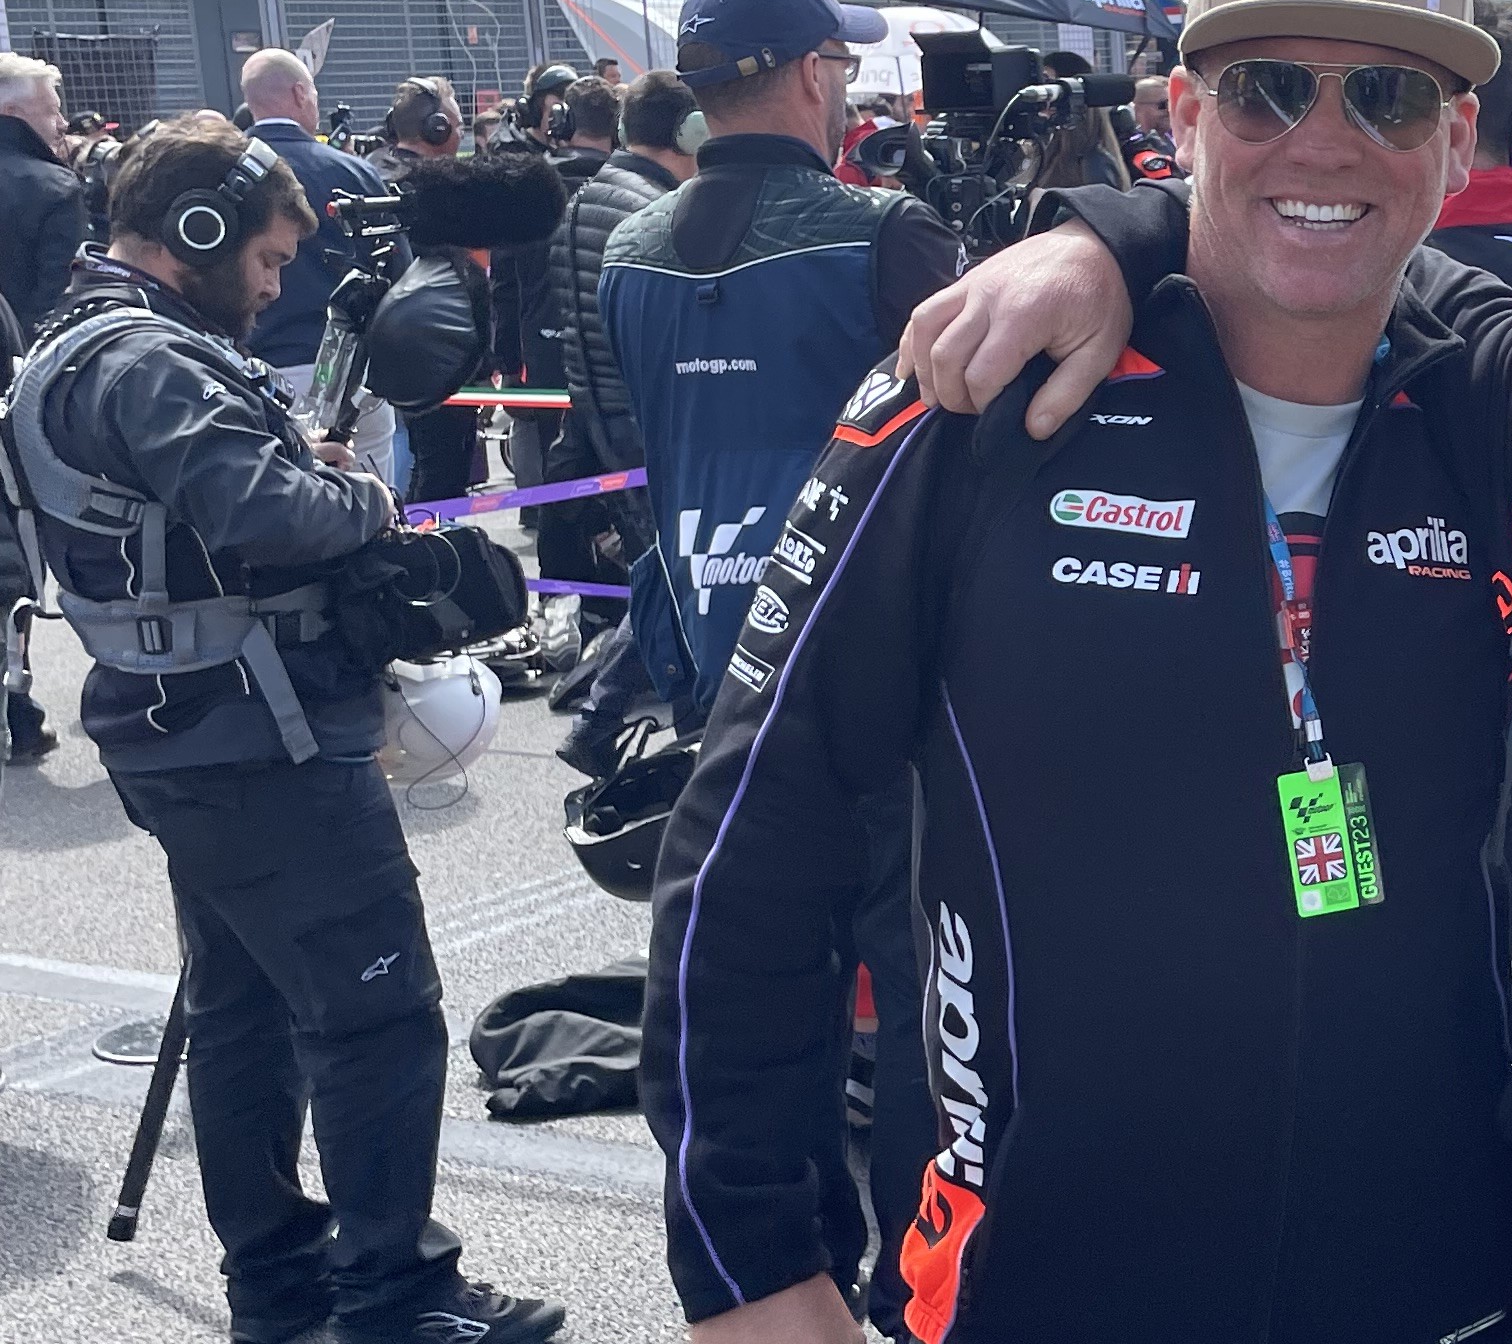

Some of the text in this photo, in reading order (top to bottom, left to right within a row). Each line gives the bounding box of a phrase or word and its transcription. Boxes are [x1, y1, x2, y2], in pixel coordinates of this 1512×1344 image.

[676, 357, 757, 374] motogp.com
[1085, 494, 1184, 533] Castrol
[1367, 515, 1468, 570] aprilia
[1052, 556, 1160, 591] CASE
[1407, 565, 1473, 581] RACING
[1350, 815, 1379, 899] GUEST23
